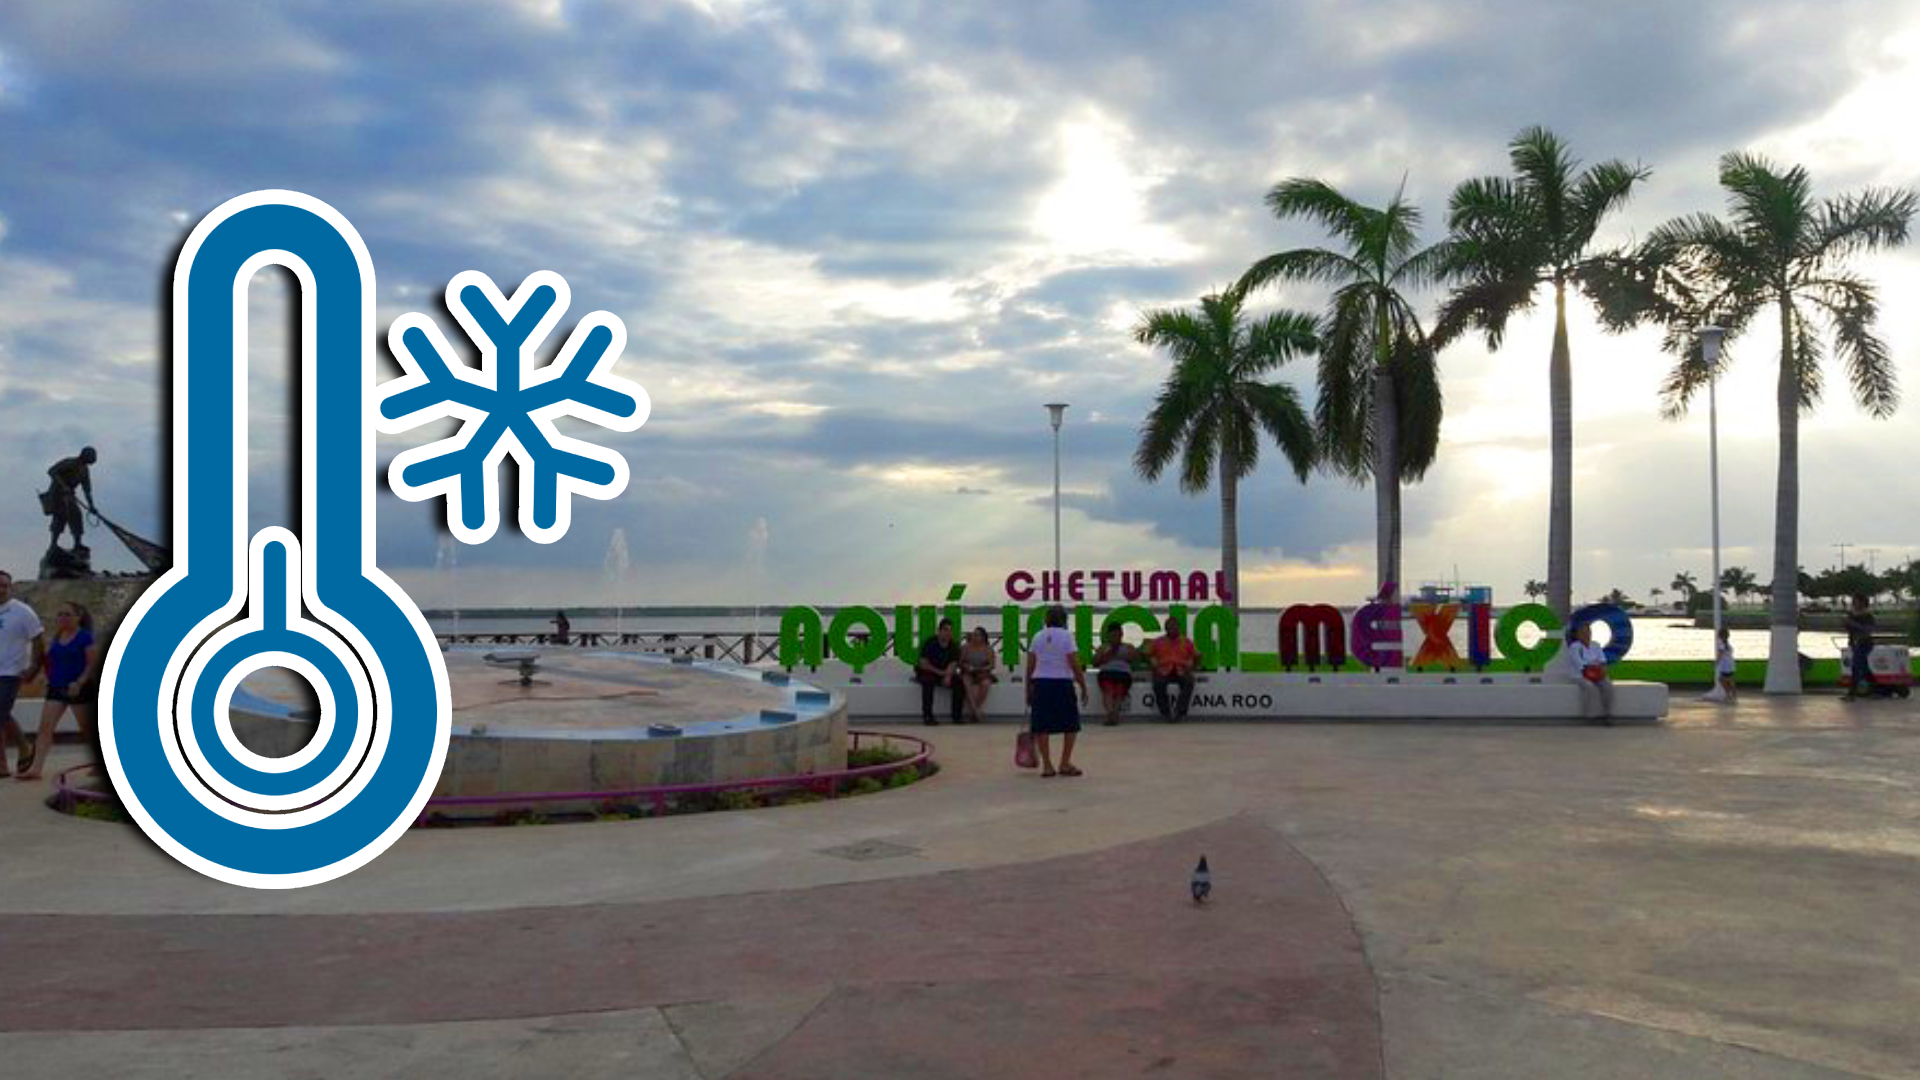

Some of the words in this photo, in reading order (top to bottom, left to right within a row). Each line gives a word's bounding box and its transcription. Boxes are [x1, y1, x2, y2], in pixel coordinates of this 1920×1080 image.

[1005, 570, 1232, 601] CHETUMAL
[1002, 604, 1237, 670] IICA
[1278, 582, 1633, 669] MÉXICO
[1142, 694, 1226, 708] QNANA
[1232, 694, 1273, 708] ROO
